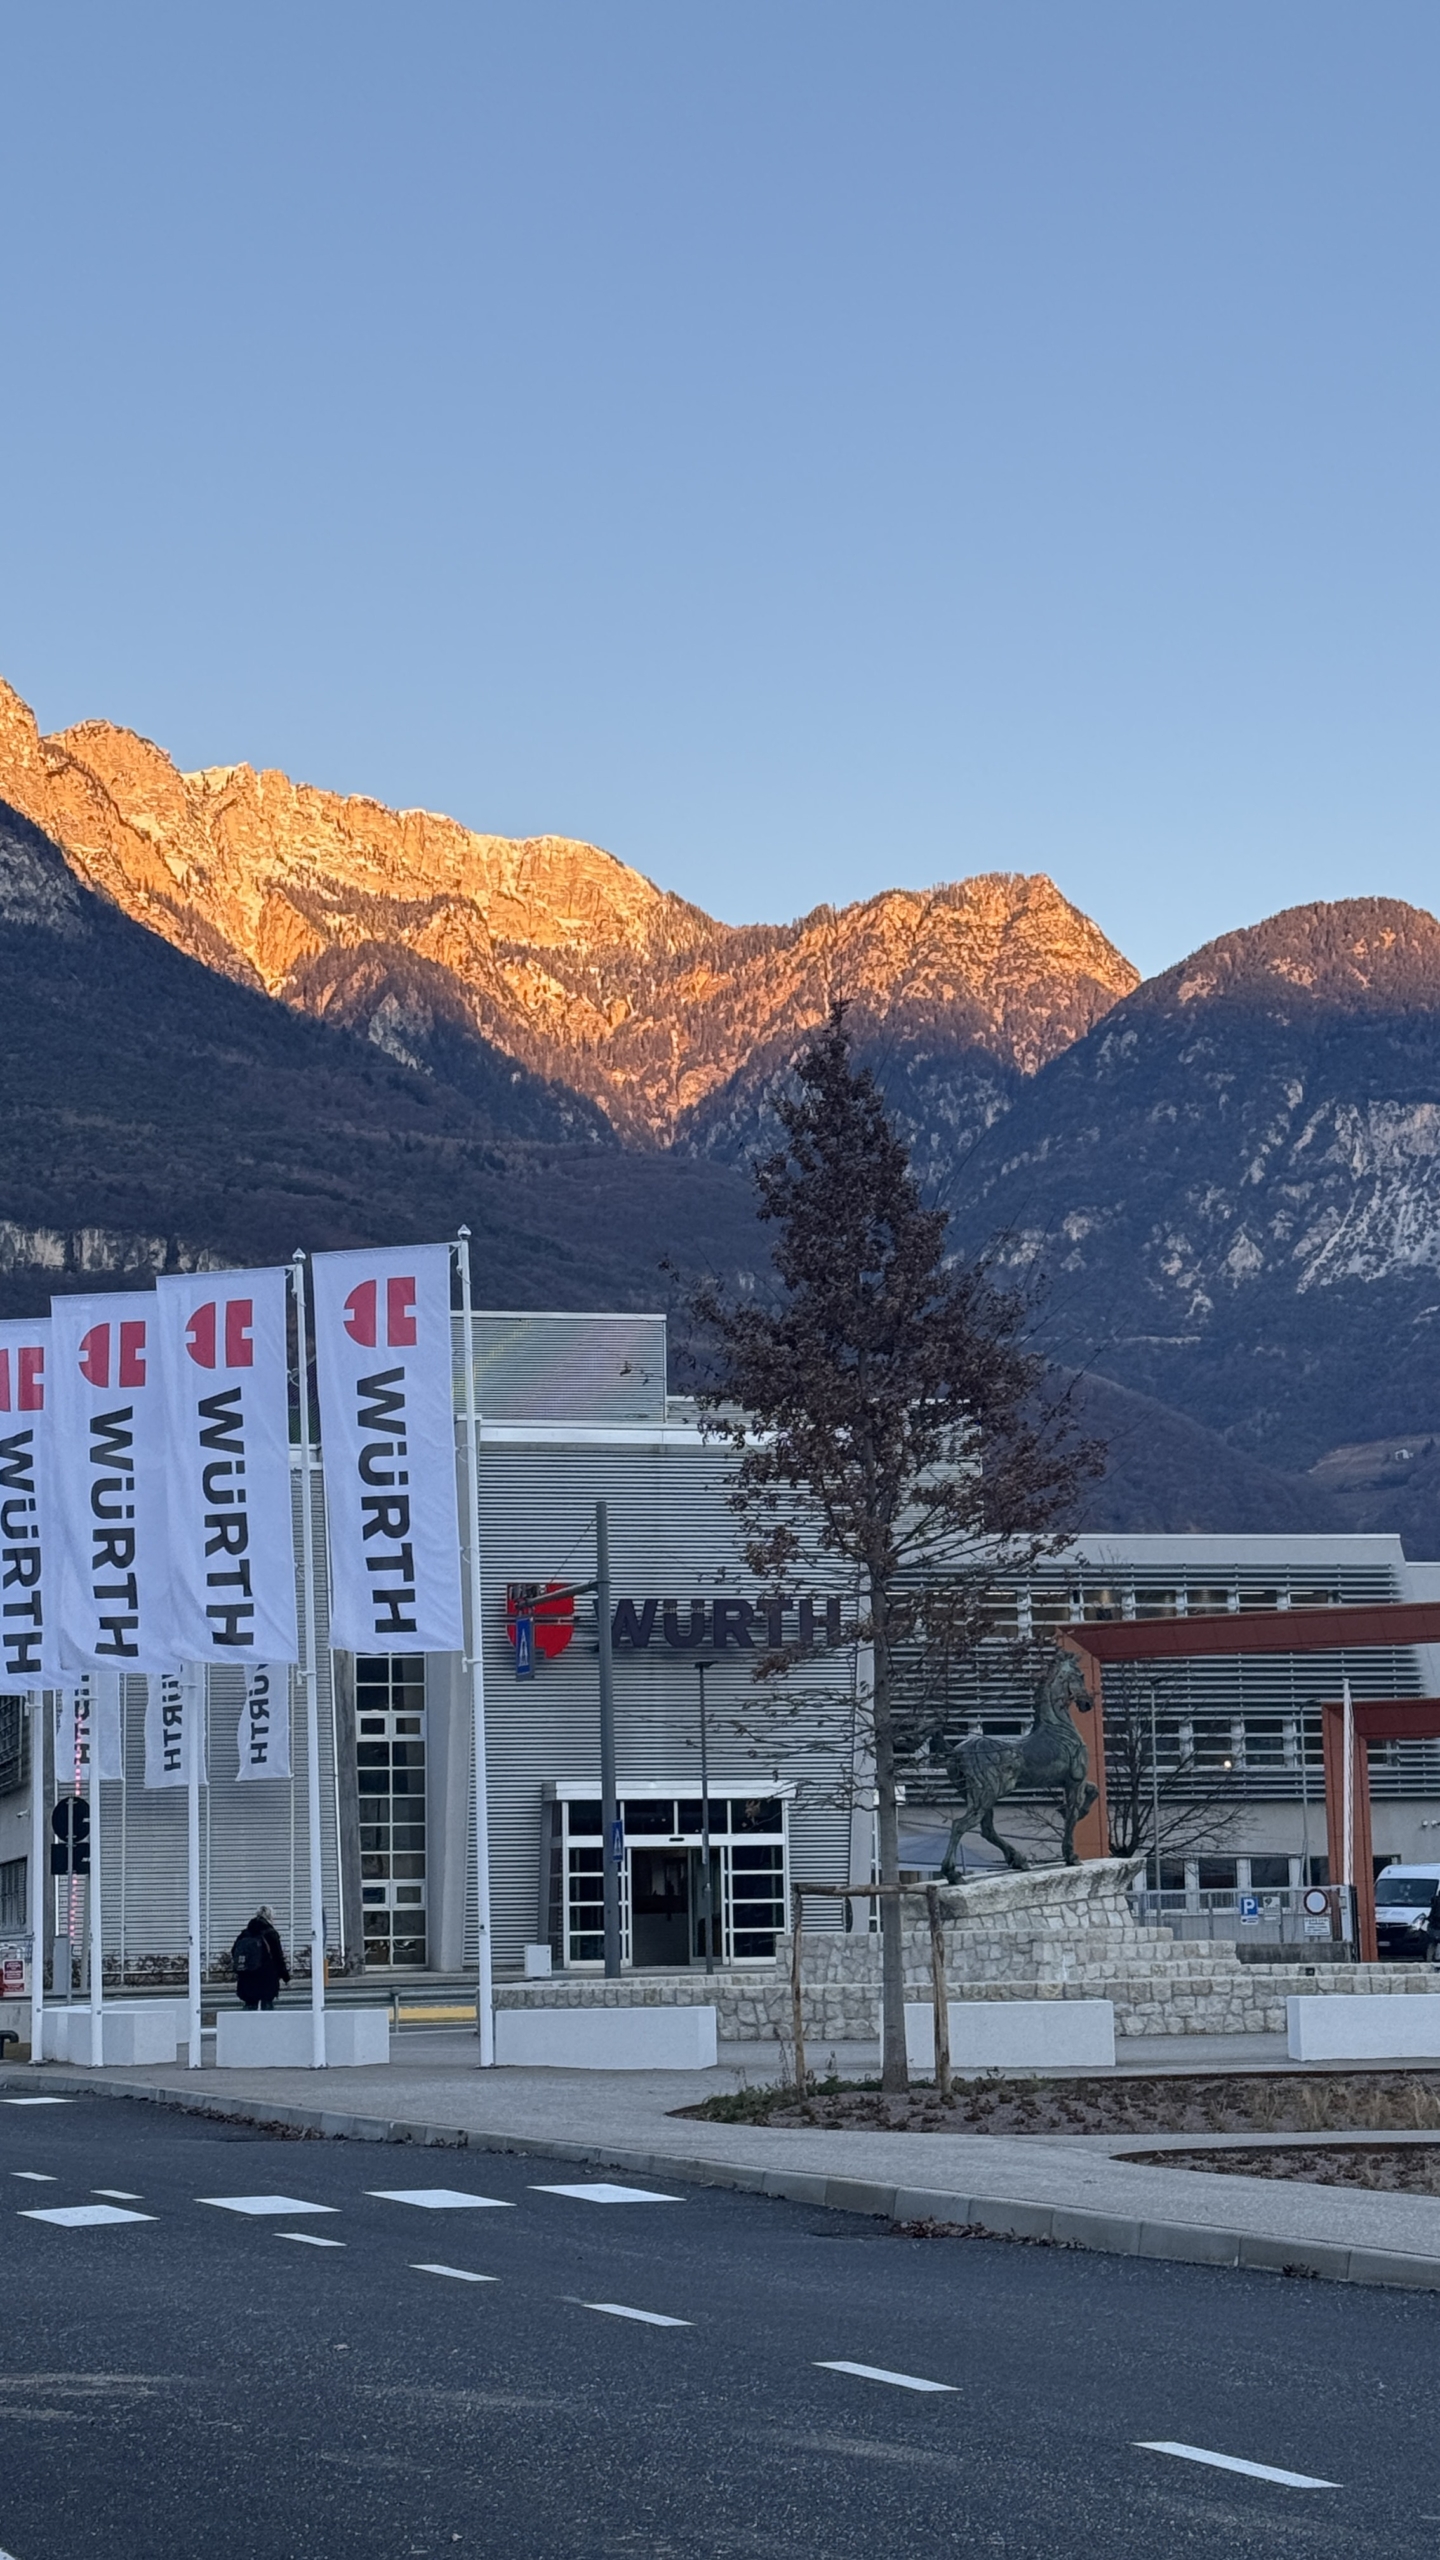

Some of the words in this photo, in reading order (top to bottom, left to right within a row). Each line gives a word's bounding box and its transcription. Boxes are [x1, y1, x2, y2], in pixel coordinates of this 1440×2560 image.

[0, 1429, 43, 1675] WÜRTH
[89, 1406, 139, 1657] WÜRTH
[198, 1387, 254, 1646] WÜRTH
[357, 1366, 417, 1633] WÜRTH
[592, 1598, 841, 1650] WÜRTH
[1243, 1898, 1255, 1914] P
